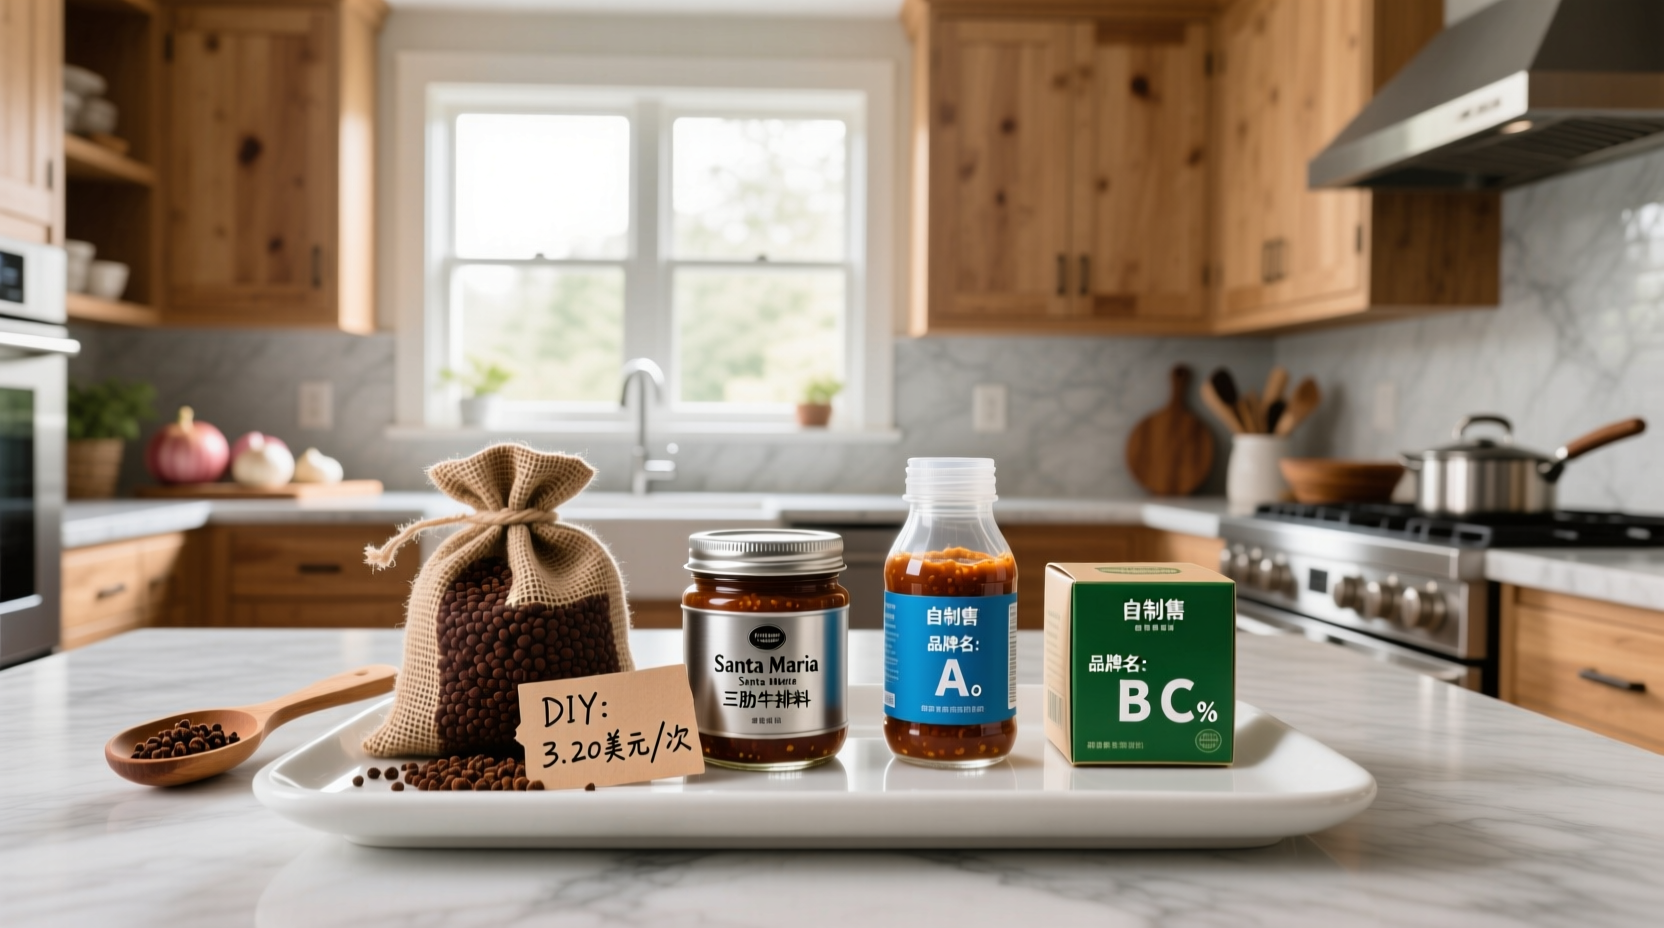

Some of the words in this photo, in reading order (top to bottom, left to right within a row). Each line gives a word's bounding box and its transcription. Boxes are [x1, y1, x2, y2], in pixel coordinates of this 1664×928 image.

[714, 654, 763, 673] Santa
[769, 655, 818, 673] Maria
[1089, 654, 1147, 673] 品牌名:
[738, 677, 765, 686] Santa
[542, 692, 607, 727] DIY:
[542, 721, 692, 768] 3.20美元/次
